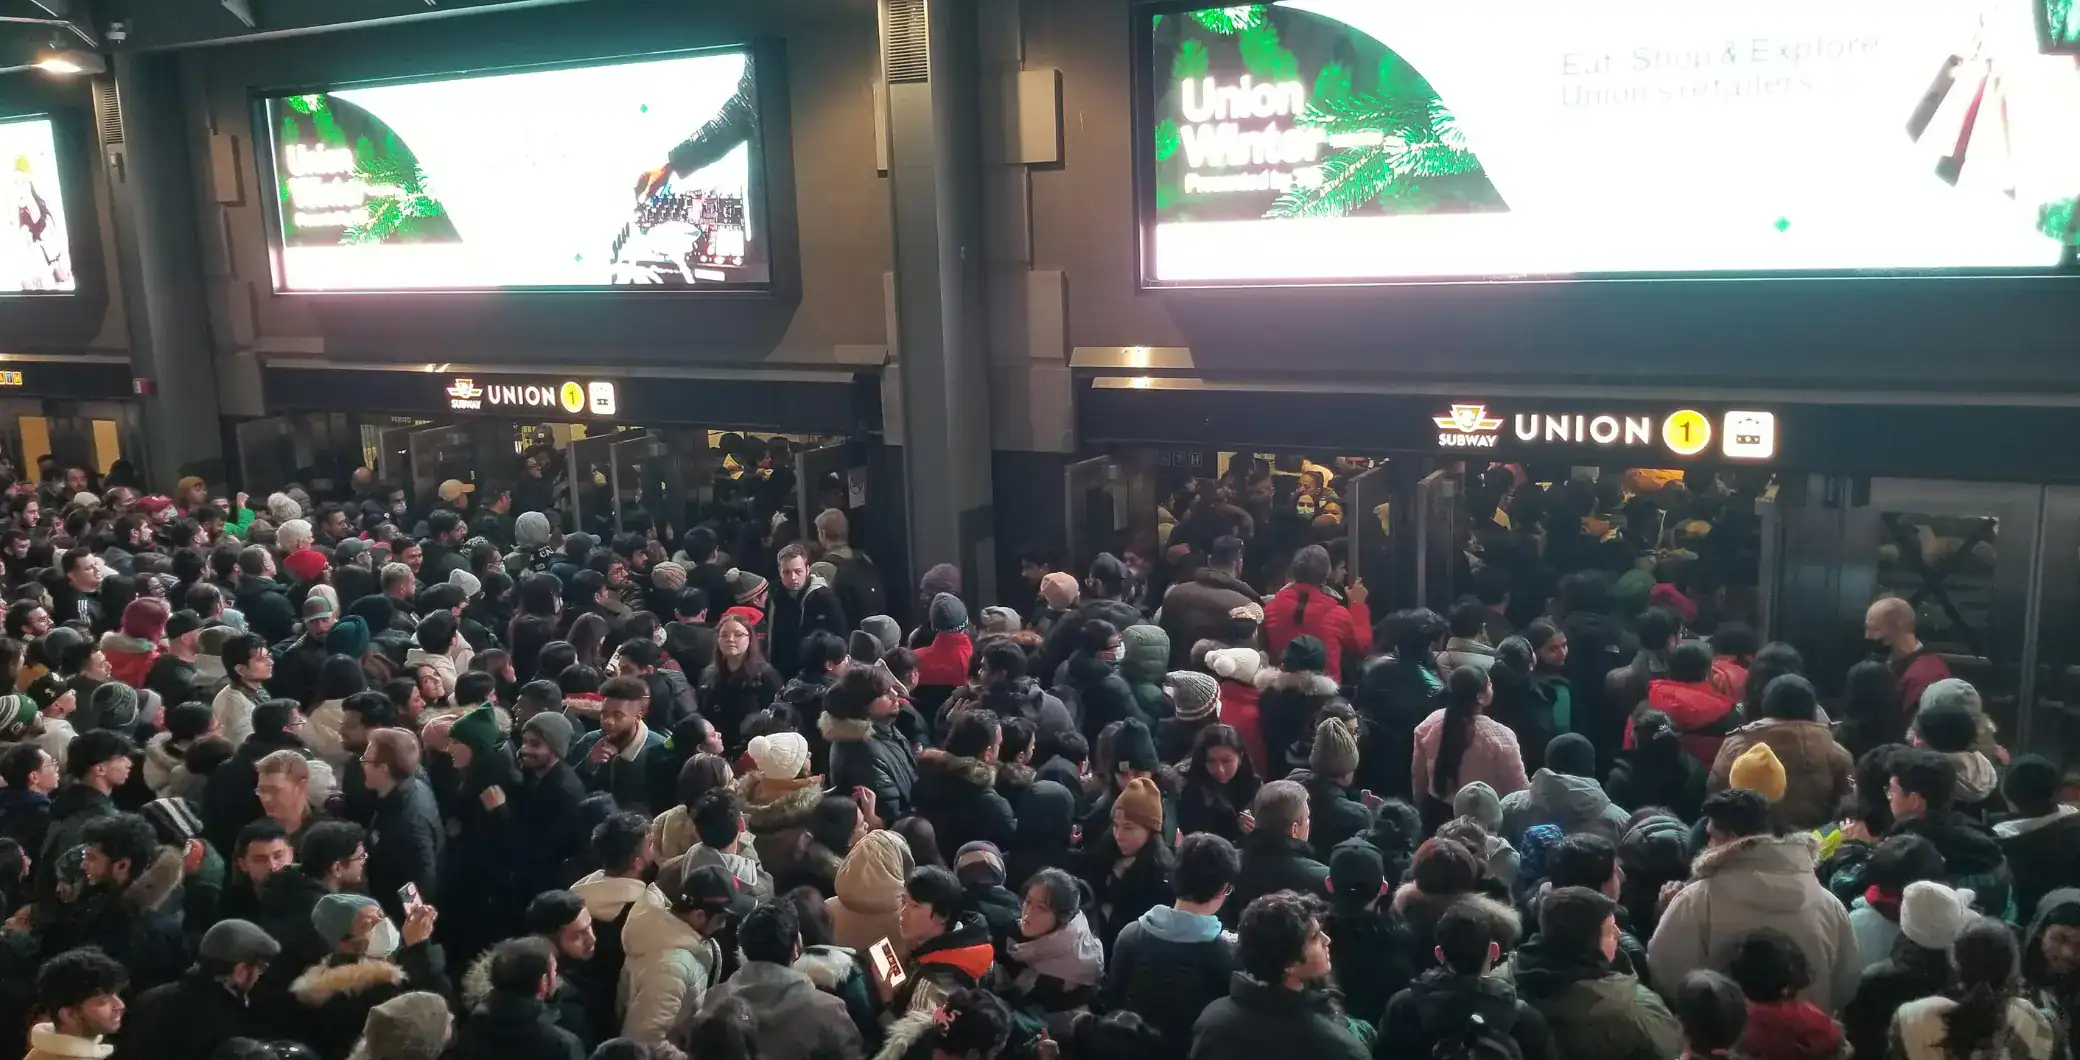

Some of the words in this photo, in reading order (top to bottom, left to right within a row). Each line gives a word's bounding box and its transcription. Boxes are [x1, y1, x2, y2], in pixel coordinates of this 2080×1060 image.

[1719, 38, 1738, 67] &
[1750, 35, 1880, 66] Explore
[1181, 75, 1305, 122] Union
[1180, 121, 1327, 168] Winter
[487, 384, 556, 407] UNION
[1438, 433, 1498, 447] SUBWAY
[1514, 413, 1651, 445] UNION
